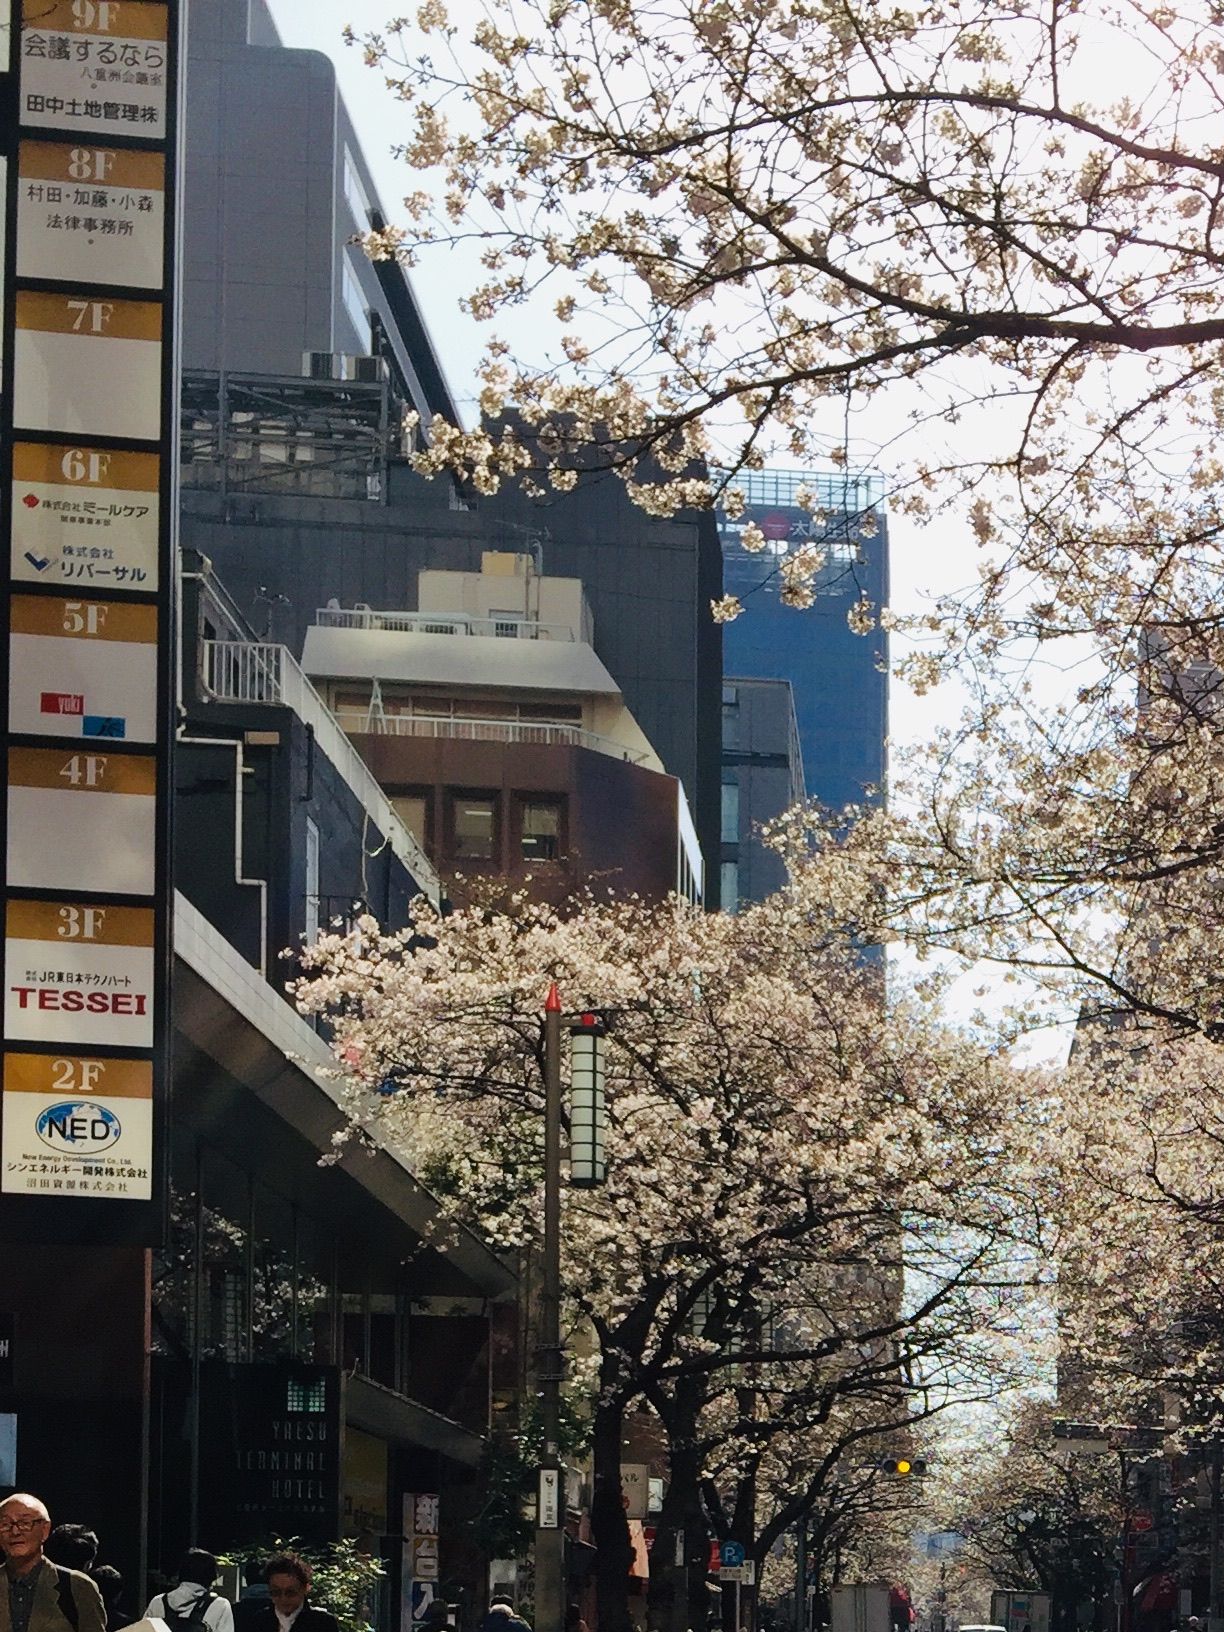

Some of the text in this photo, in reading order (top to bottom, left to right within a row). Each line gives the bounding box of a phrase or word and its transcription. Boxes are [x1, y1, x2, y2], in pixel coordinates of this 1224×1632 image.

[71, 0, 120, 31] 9F
[24, 33, 164, 68] 会議するなら
[26, 94, 158, 123] 田中土地管理株
[69, 148, 116, 181] 8F
[46, 214, 134, 236] 法律事務所
[66, 301, 114, 332] 7F
[61, 450, 111, 482] 6F
[62, 545, 114, 560] 株式会社
[61, 561, 147, 581] リバーサル
[63, 602, 108, 634] 5F
[59, 755, 107, 786] 4F
[57, 906, 106, 938] 3F
[11, 987, 147, 1016] TESSEI
[51, 1059, 106, 1091] 2F
[48, 1117, 111, 1141] NED
[7, 1162, 148, 1179] シンエネルギー開発株式会社
[272, 1421, 327, 1440] YAESU
[235, 1451, 326, 1471] TERMINAL
[272, 1479, 324, 1499] HOTEL
